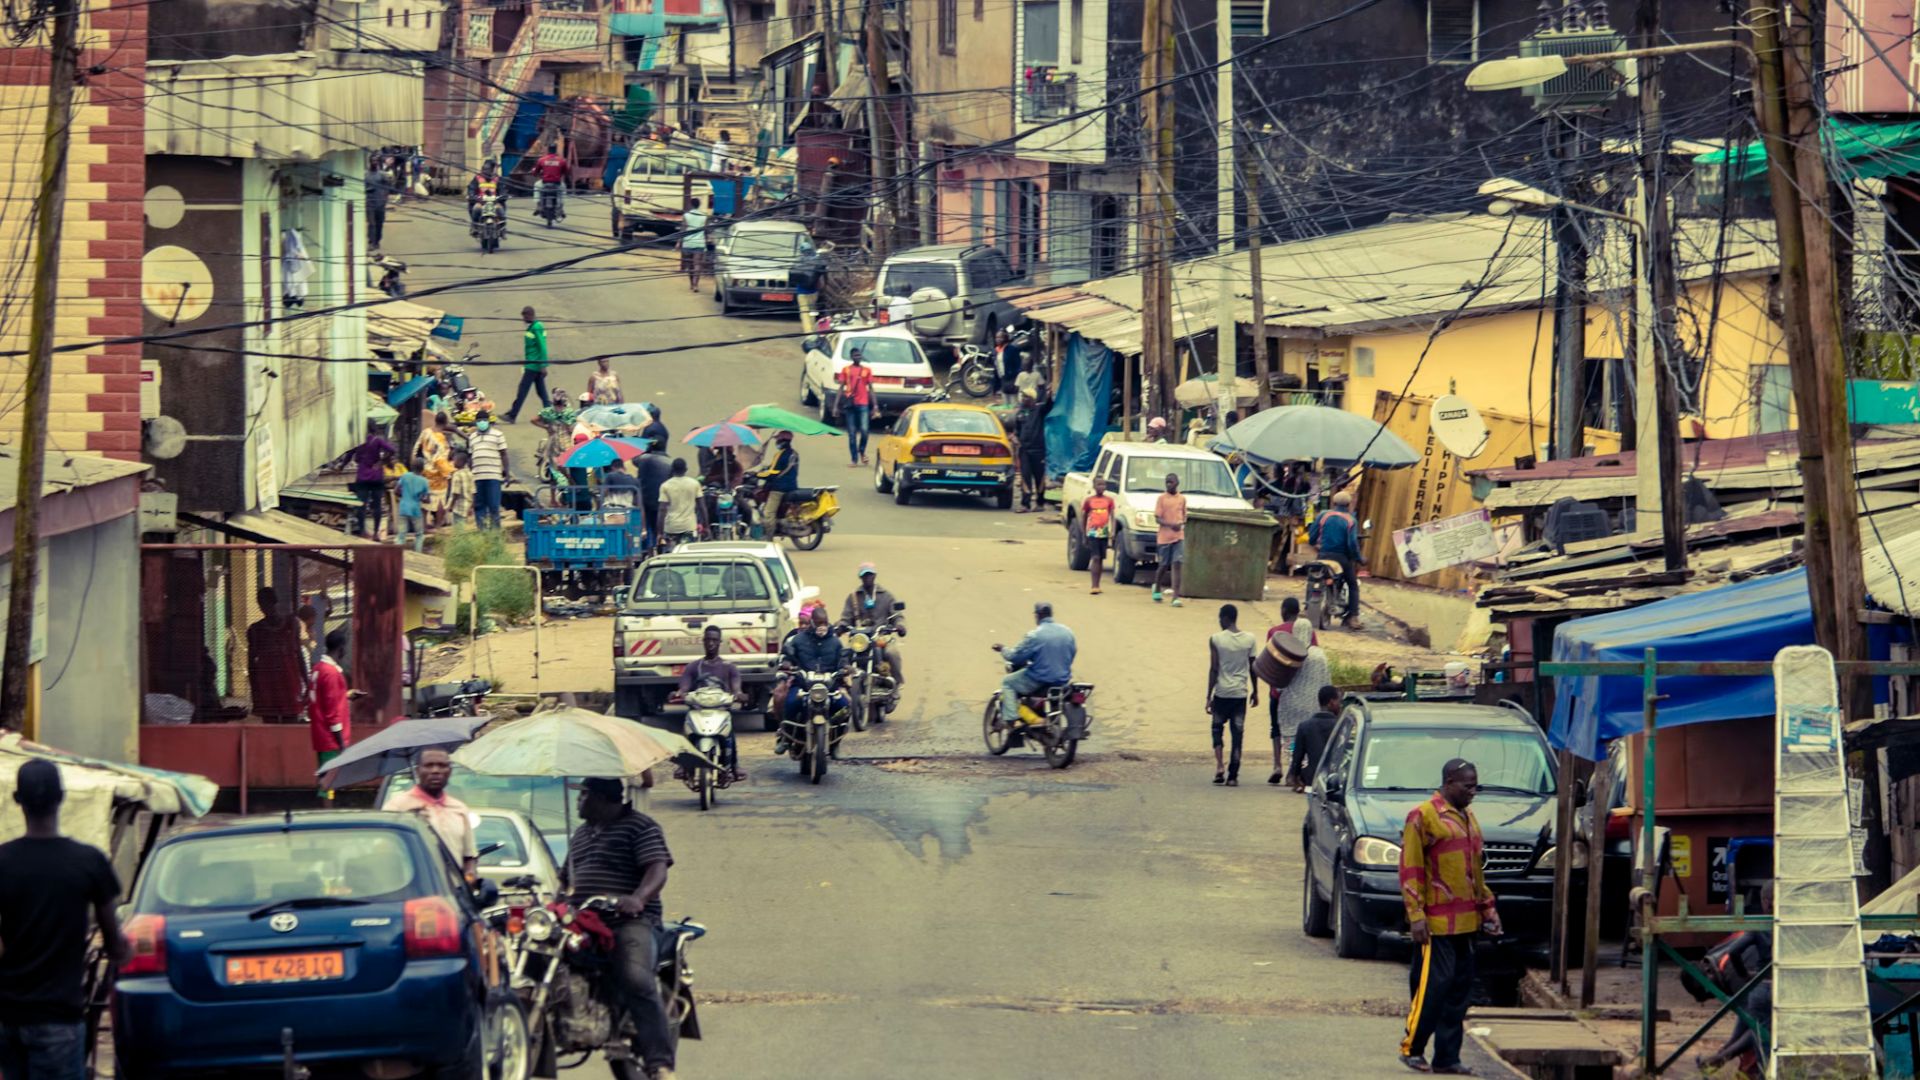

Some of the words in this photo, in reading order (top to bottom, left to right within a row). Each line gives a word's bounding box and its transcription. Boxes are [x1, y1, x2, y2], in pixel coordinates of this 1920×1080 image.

[1411, 425, 1435, 526] EDITERRA
[1431, 449, 1451, 521] HIPPIN
[667, 636, 703, 646] MITSUB
[1712, 871, 1728, 881] Ora
[243, 960, 267, 979] LT
[273, 958, 306, 977] 428
